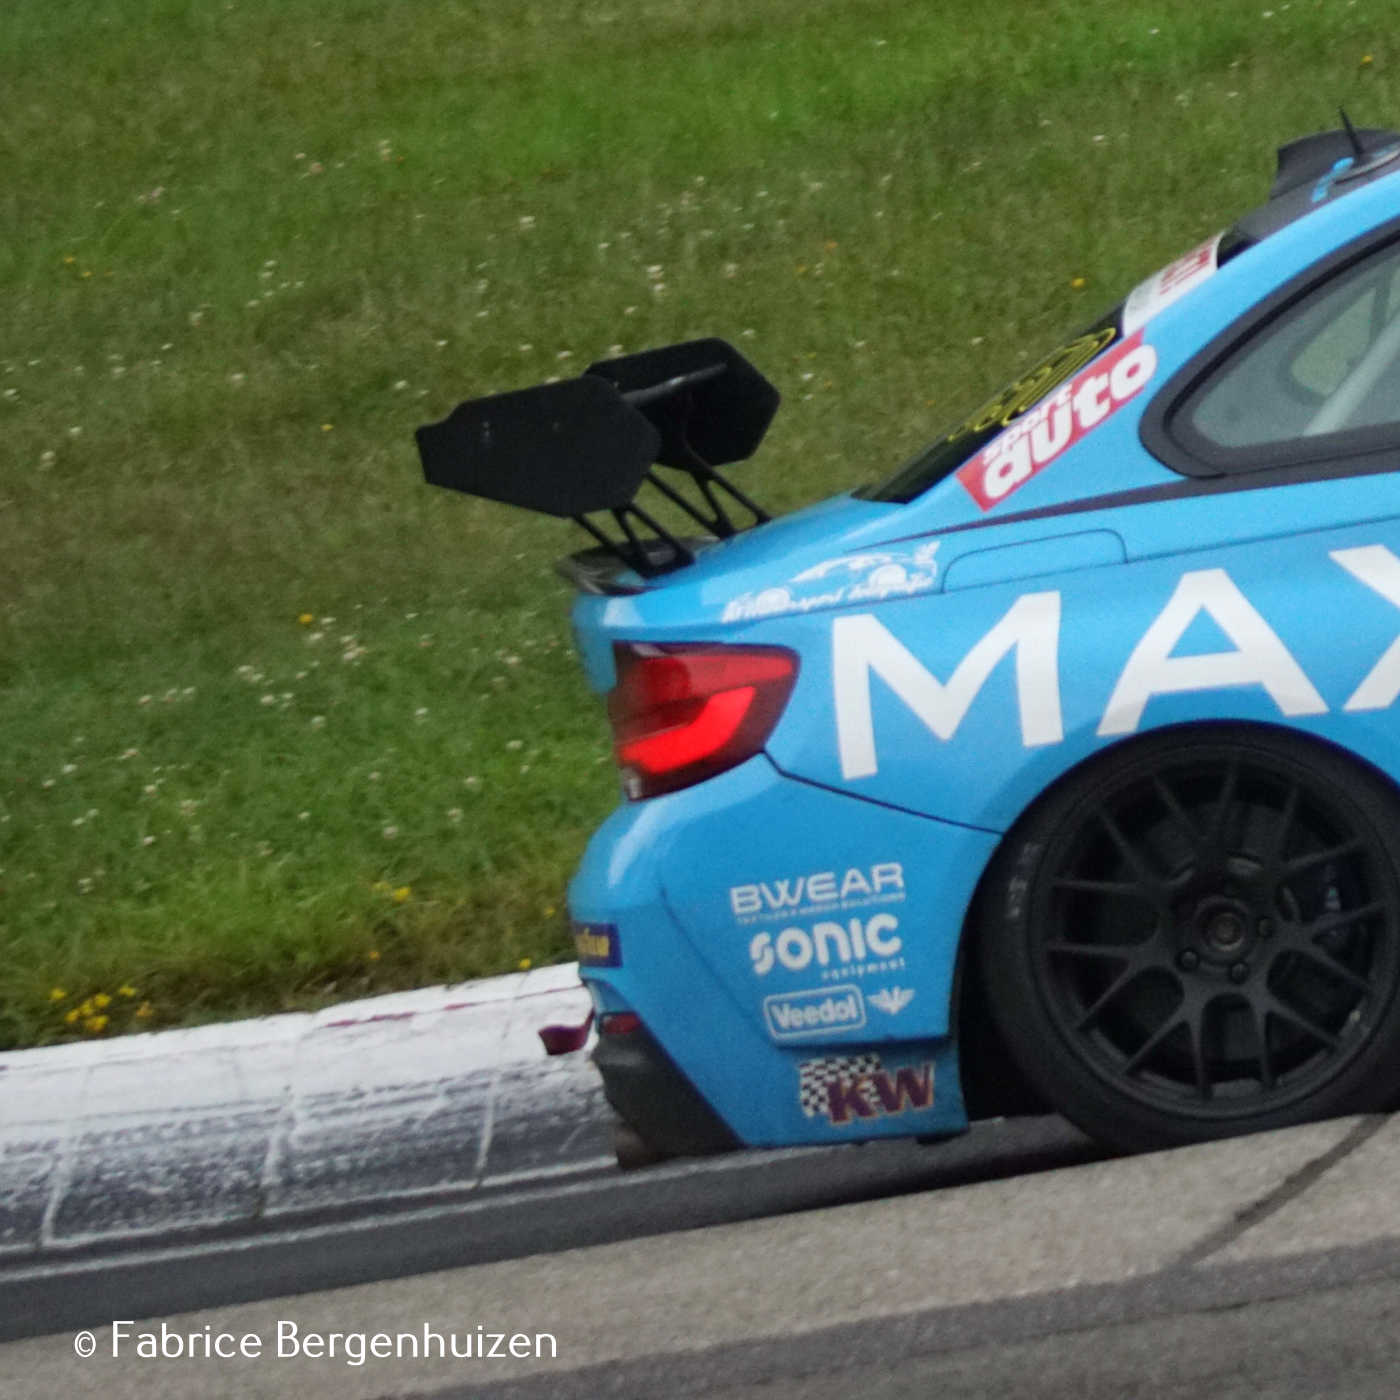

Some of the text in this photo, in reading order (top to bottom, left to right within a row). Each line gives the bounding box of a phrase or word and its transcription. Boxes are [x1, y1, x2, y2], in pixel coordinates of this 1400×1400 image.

[983, 343, 1158, 500] auto
[729, 861, 905, 917] BWEAR
[771, 995, 858, 1030] Veedol
